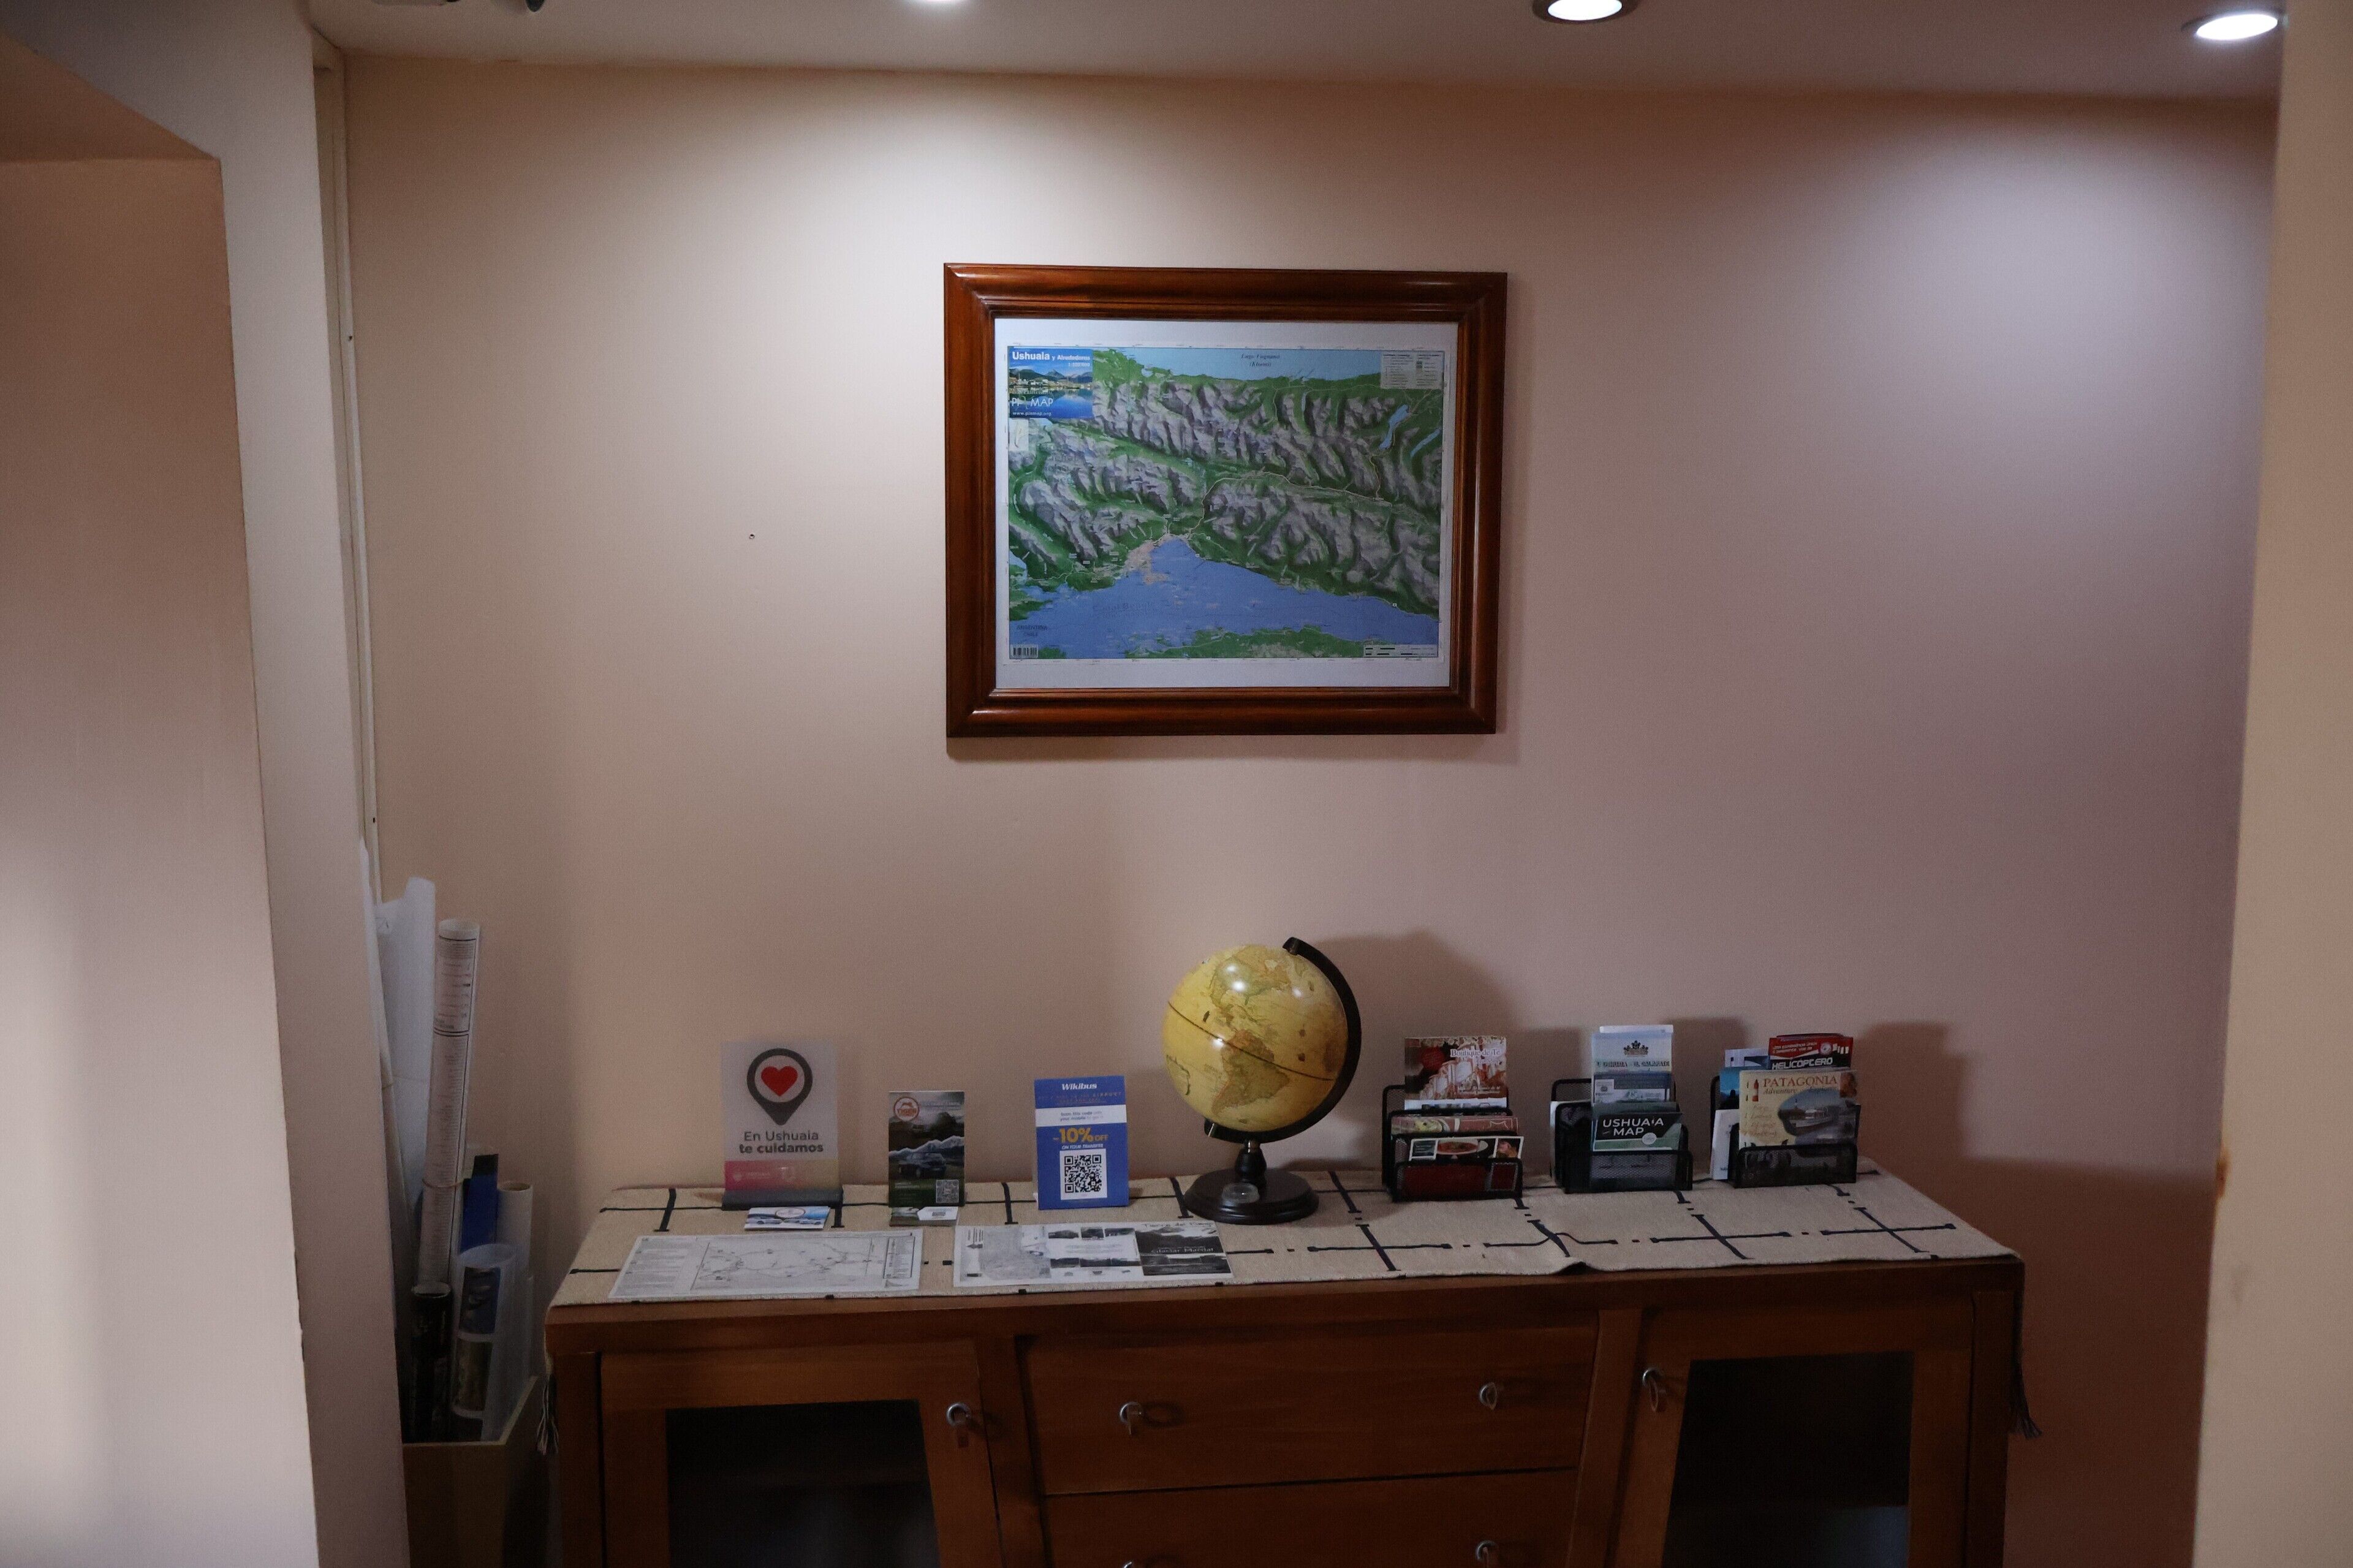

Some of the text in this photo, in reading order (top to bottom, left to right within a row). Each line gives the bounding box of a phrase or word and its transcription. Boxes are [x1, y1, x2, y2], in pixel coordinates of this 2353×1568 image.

[1012, 351, 1050, 360] Ushuaia
[1772, 1057, 1833, 1070] HELICÓPTERO
[1764, 1075, 1838, 1088] PATAGONIA
[743, 1131, 819, 1142] En Ushuaia
[1613, 1127, 1644, 1137] MAP
[739, 1143, 824, 1154] te cuidamos
